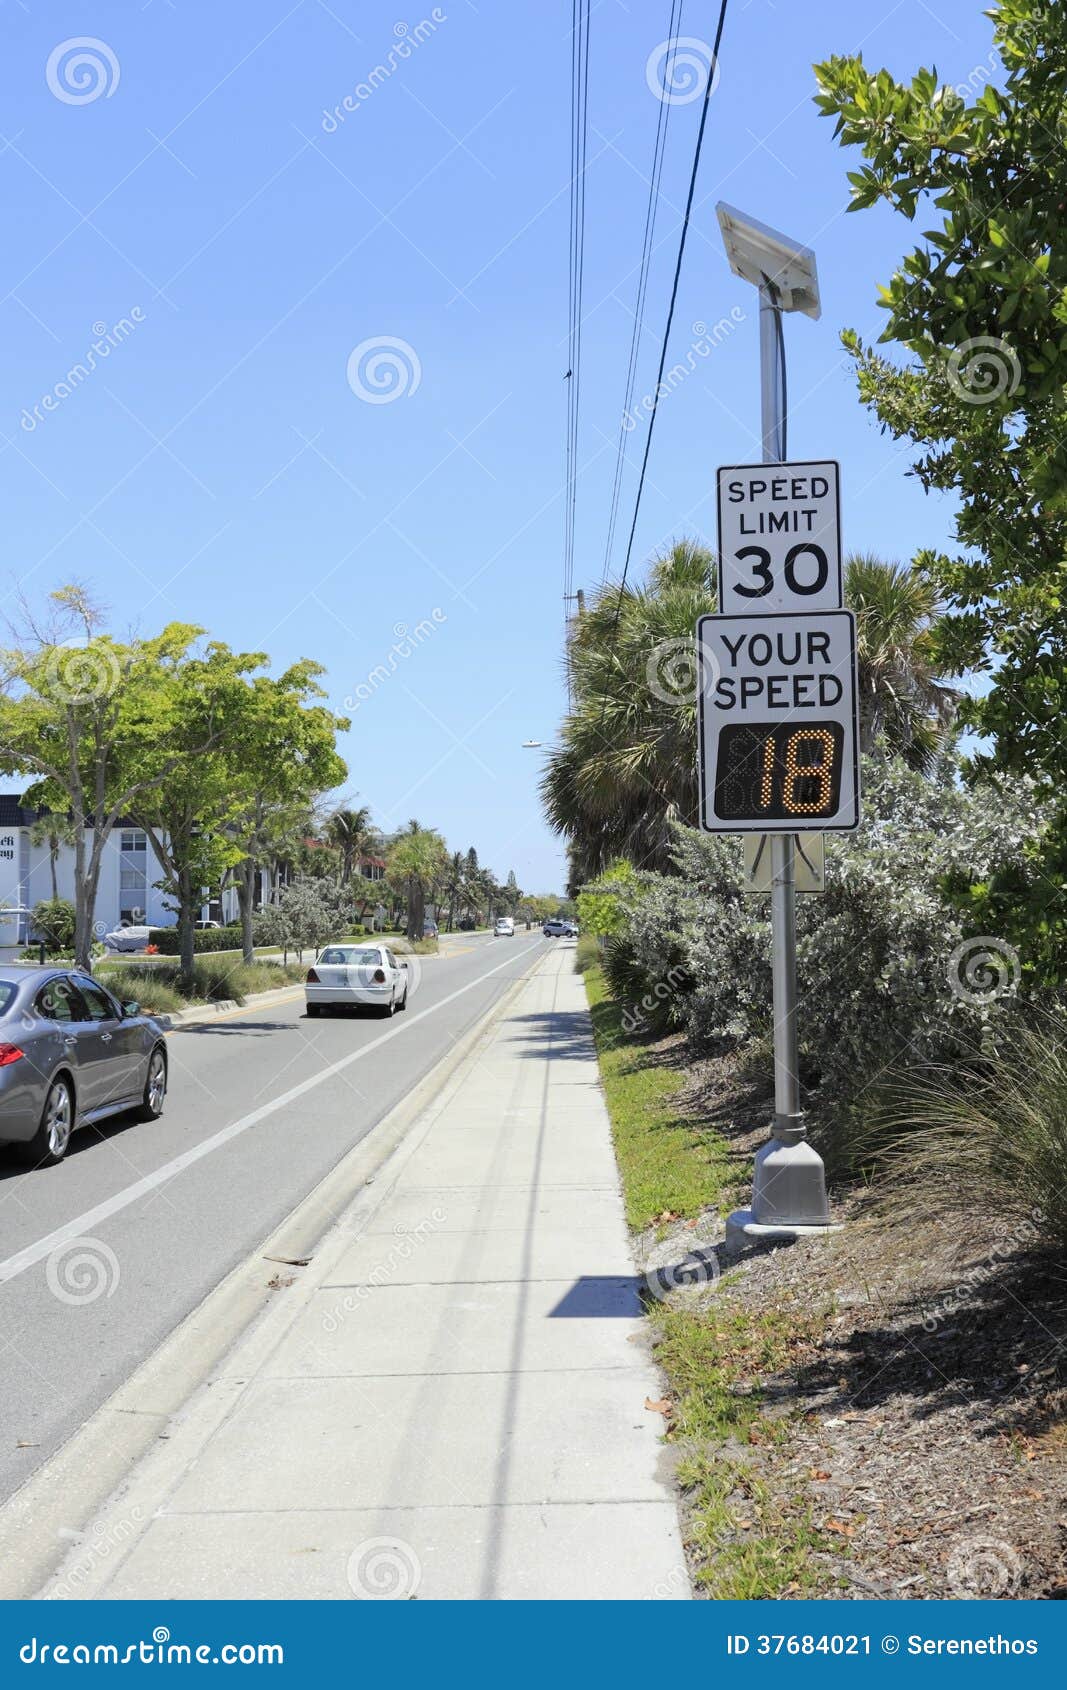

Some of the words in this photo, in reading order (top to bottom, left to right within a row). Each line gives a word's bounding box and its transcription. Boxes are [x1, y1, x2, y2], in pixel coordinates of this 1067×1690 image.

[728, 477, 829, 503] SPEED
[740, 509, 818, 535] LIMIT
[732, 542, 829, 598] 30
[720, 631, 832, 667] YOUR
[714, 674, 843, 710] SPEED
[760, 729, 835, 814] 18
